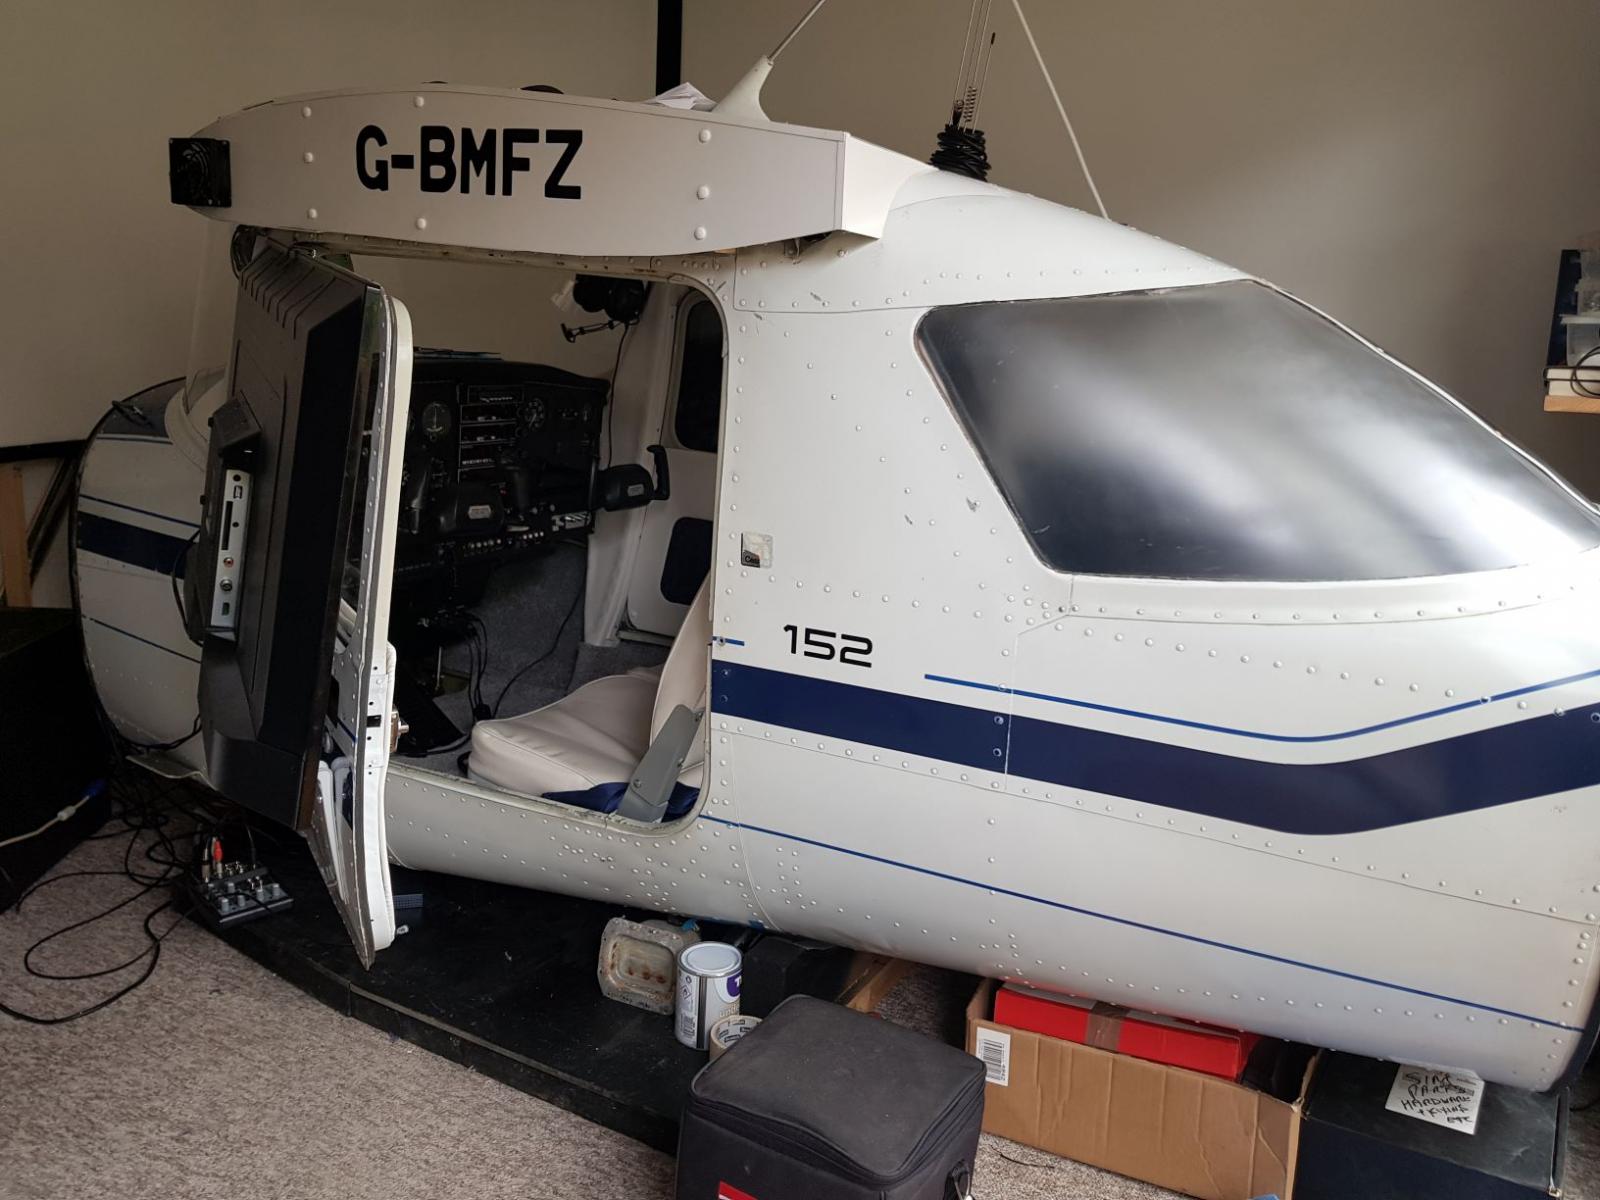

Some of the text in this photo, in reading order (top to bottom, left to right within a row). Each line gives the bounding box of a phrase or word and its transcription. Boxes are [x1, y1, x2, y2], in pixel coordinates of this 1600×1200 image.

[356, 124, 583, 200] G-BMFZ
[783, 624, 873, 668] 152
[1405, 1071, 1451, 1084] SIM
[1401, 1095, 1471, 1110] HARDWARE
